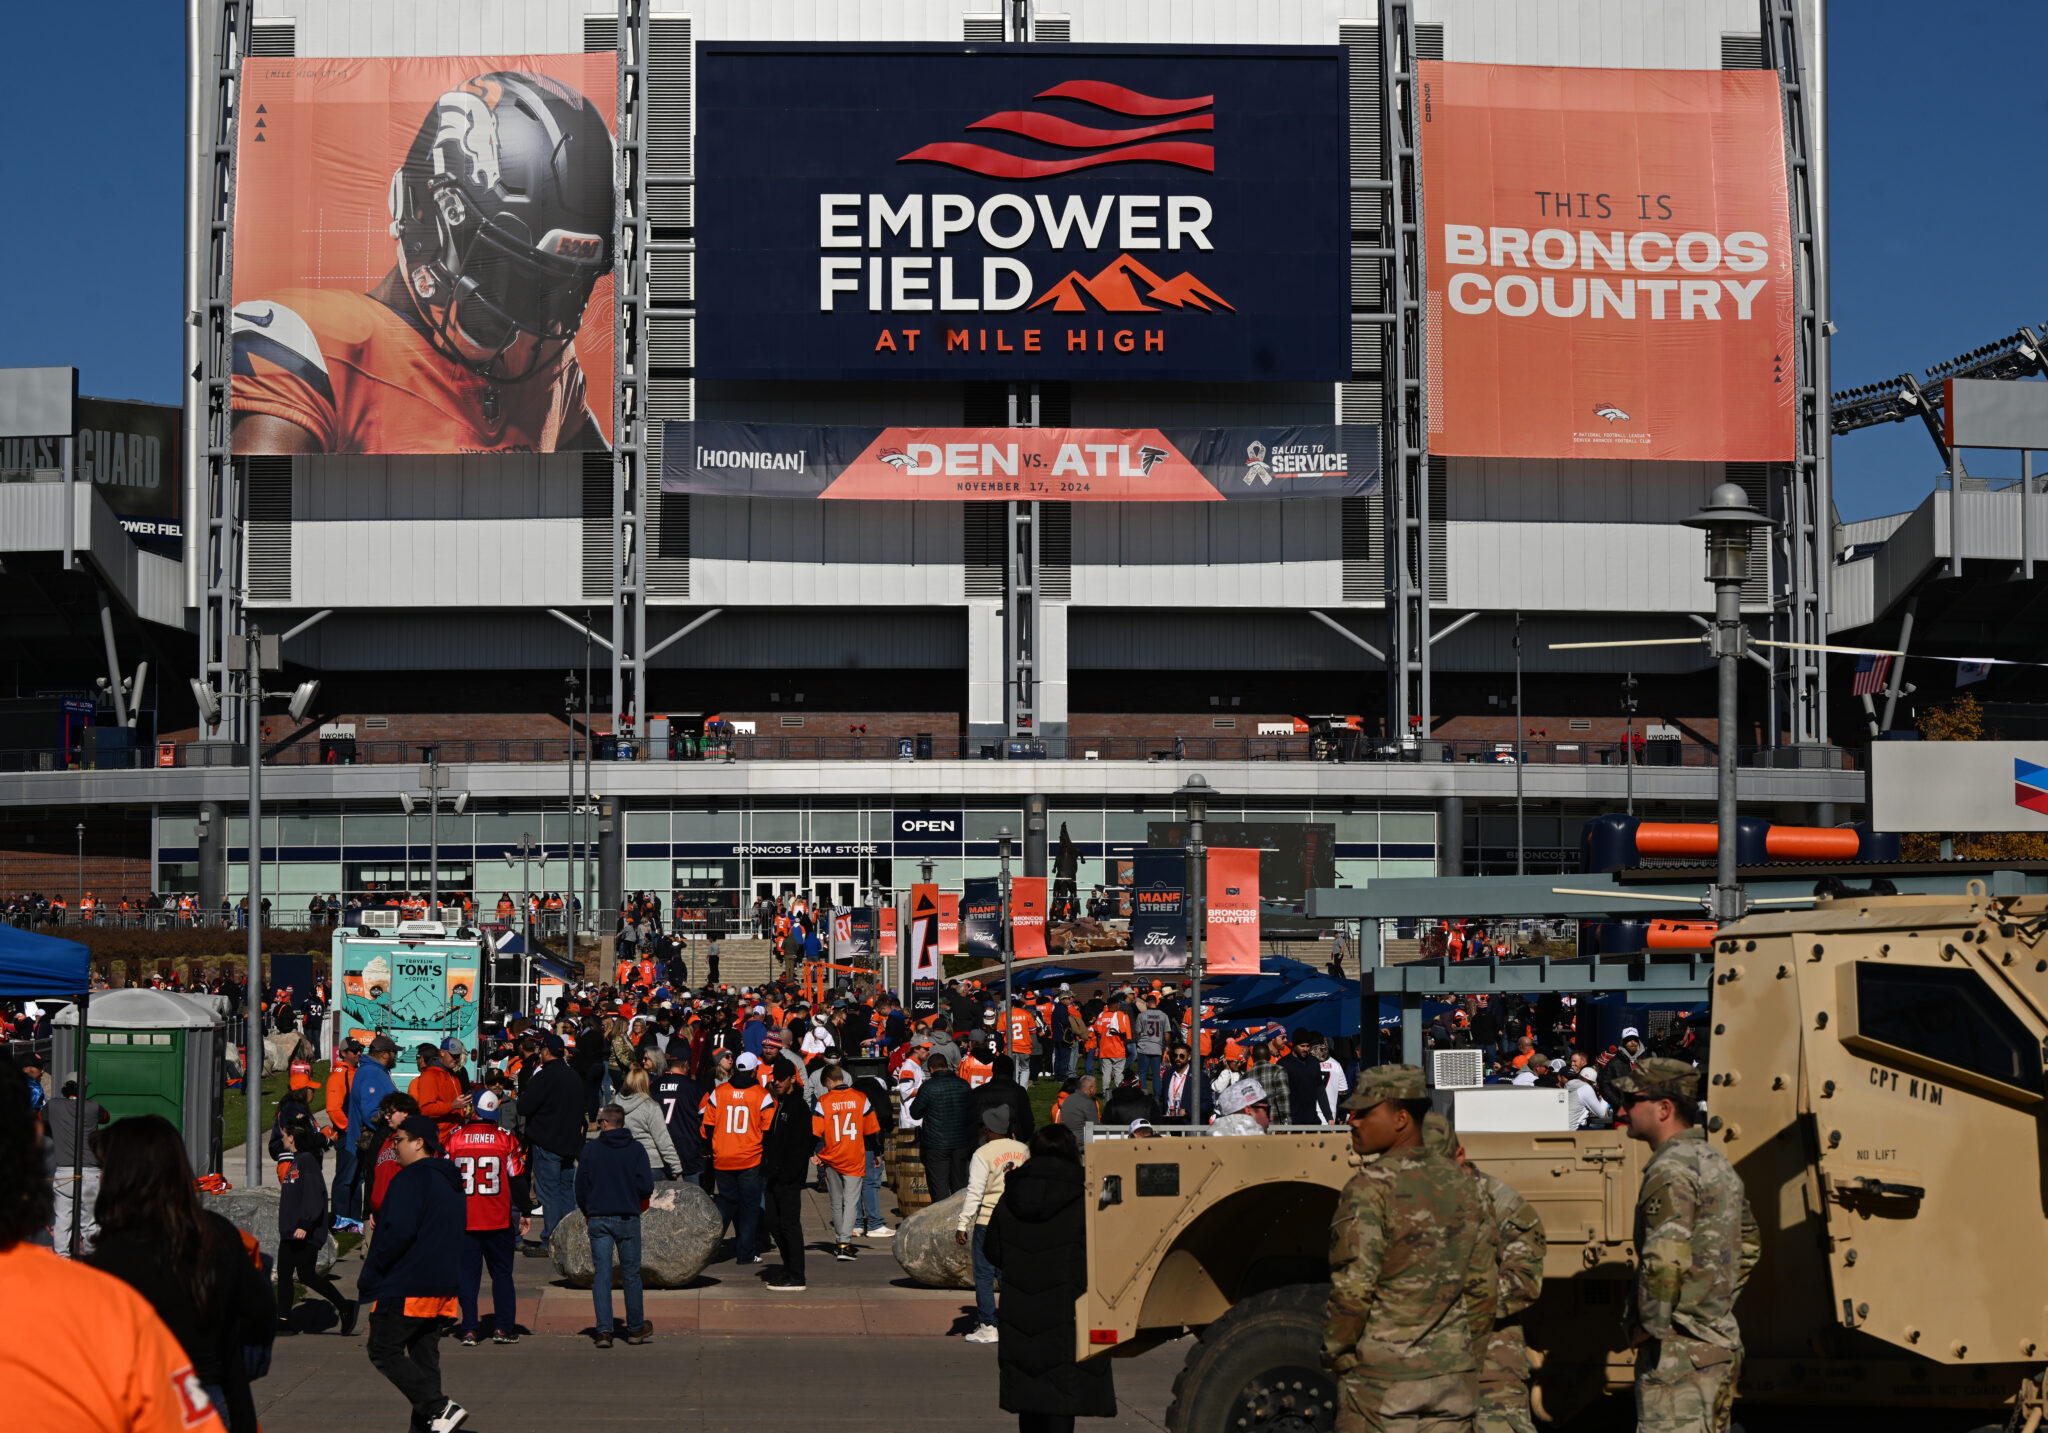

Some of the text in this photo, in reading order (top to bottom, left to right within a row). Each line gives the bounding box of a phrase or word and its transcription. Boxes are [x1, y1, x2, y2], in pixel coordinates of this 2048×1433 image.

[1424, 83, 1432, 122] 5280
[1535, 191, 1673, 220] THIS IS
[820, 193, 1214, 249] EMPOWER
[1444, 223, 1769, 272] BRONCOS
[820, 257, 1033, 311] FIELD
[1448, 272, 1768, 320] COUNTRY
[875, 330, 1164, 352] AT MILE HIGH
[1272, 445, 1324, 455] SALUTE TO
[78, 428, 161, 489] GUARD
[907, 443, 1148, 477] DEN VS. ATL
[1272, 453, 1348, 473] SERVICE
[957, 482, 1091, 493] NOVEMBER 17, 2024
[902, 820, 955, 832] OPEN
[732, 846, 878, 855] BRONCOS TEAM STORE
[1139, 892, 1181, 903] MANE
[968, 906, 997, 914] MANE
[1139, 903, 1179, 912] STREET
[1208, 916, 1256, 924] COUNTRY
[973, 931, 995, 941] Ford
[1144, 931, 1176, 946] Ford
[396, 964, 442, 976] TOM'S
[310, 1005, 322, 1016] 30
[915, 1000, 935, 1009] Ford
[1011, 1022, 1024, 1040] 2
[1147, 1021, 1160, 1037] 31
[713, 1033, 725, 1048] 11
[1870, 1067, 1943, 1106] CPT KIM
[732, 1091, 744, 1099] NIX
[663, 1098, 676, 1125] 7
[832, 1101, 857, 1111] SUTTON
[726, 1105, 750, 1134] 10
[832, 1112, 858, 1142] 14
[464, 1133, 496, 1144] TURNER
[1857, 1149, 1896, 1160] NO LIFT
[454, 1155, 501, 1196] 33
